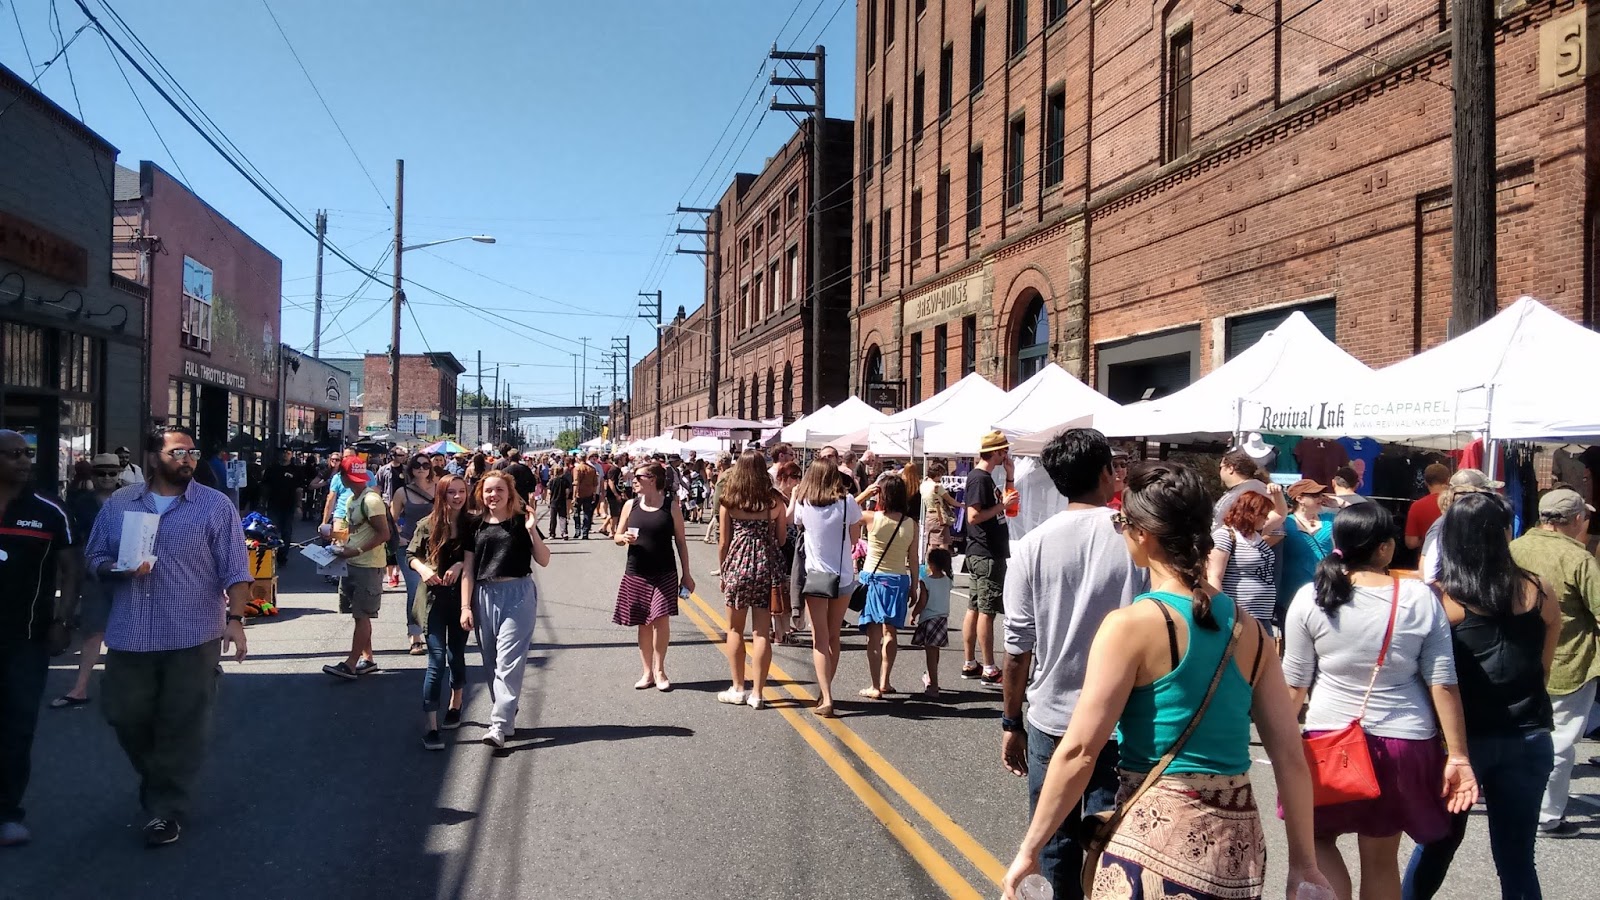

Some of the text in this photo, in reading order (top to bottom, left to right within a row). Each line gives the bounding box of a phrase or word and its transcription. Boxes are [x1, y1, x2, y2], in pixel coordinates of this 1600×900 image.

[185, 360, 246, 389] FULL THROTTLE BOTTLES
[1259, 402, 1345, 431] Revival Ink
[16, 518, 43, 529] aprilia
